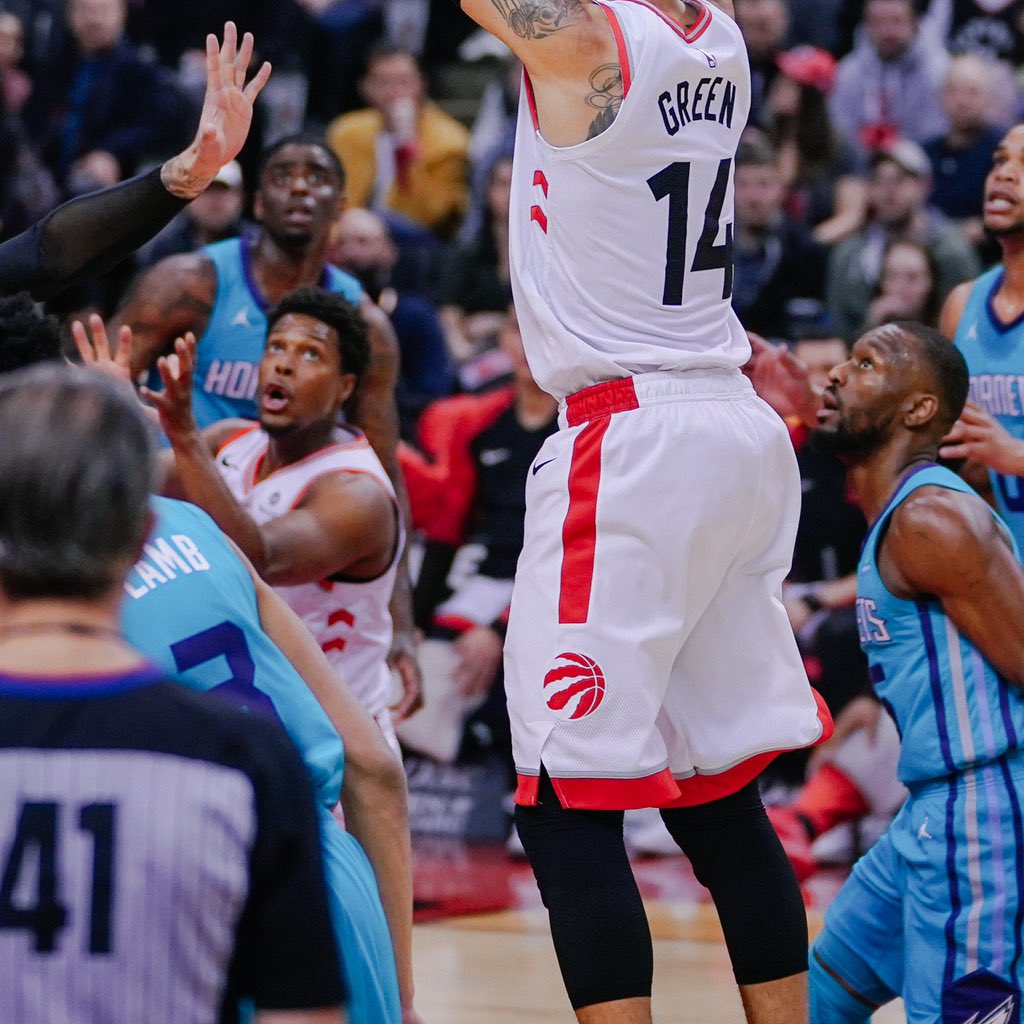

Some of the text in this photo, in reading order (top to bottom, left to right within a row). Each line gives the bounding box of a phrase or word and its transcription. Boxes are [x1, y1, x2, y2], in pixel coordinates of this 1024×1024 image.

[658, 76, 736, 136] GREEN
[646, 157, 733, 306] 14
[123, 534, 210, 599] LAMB
